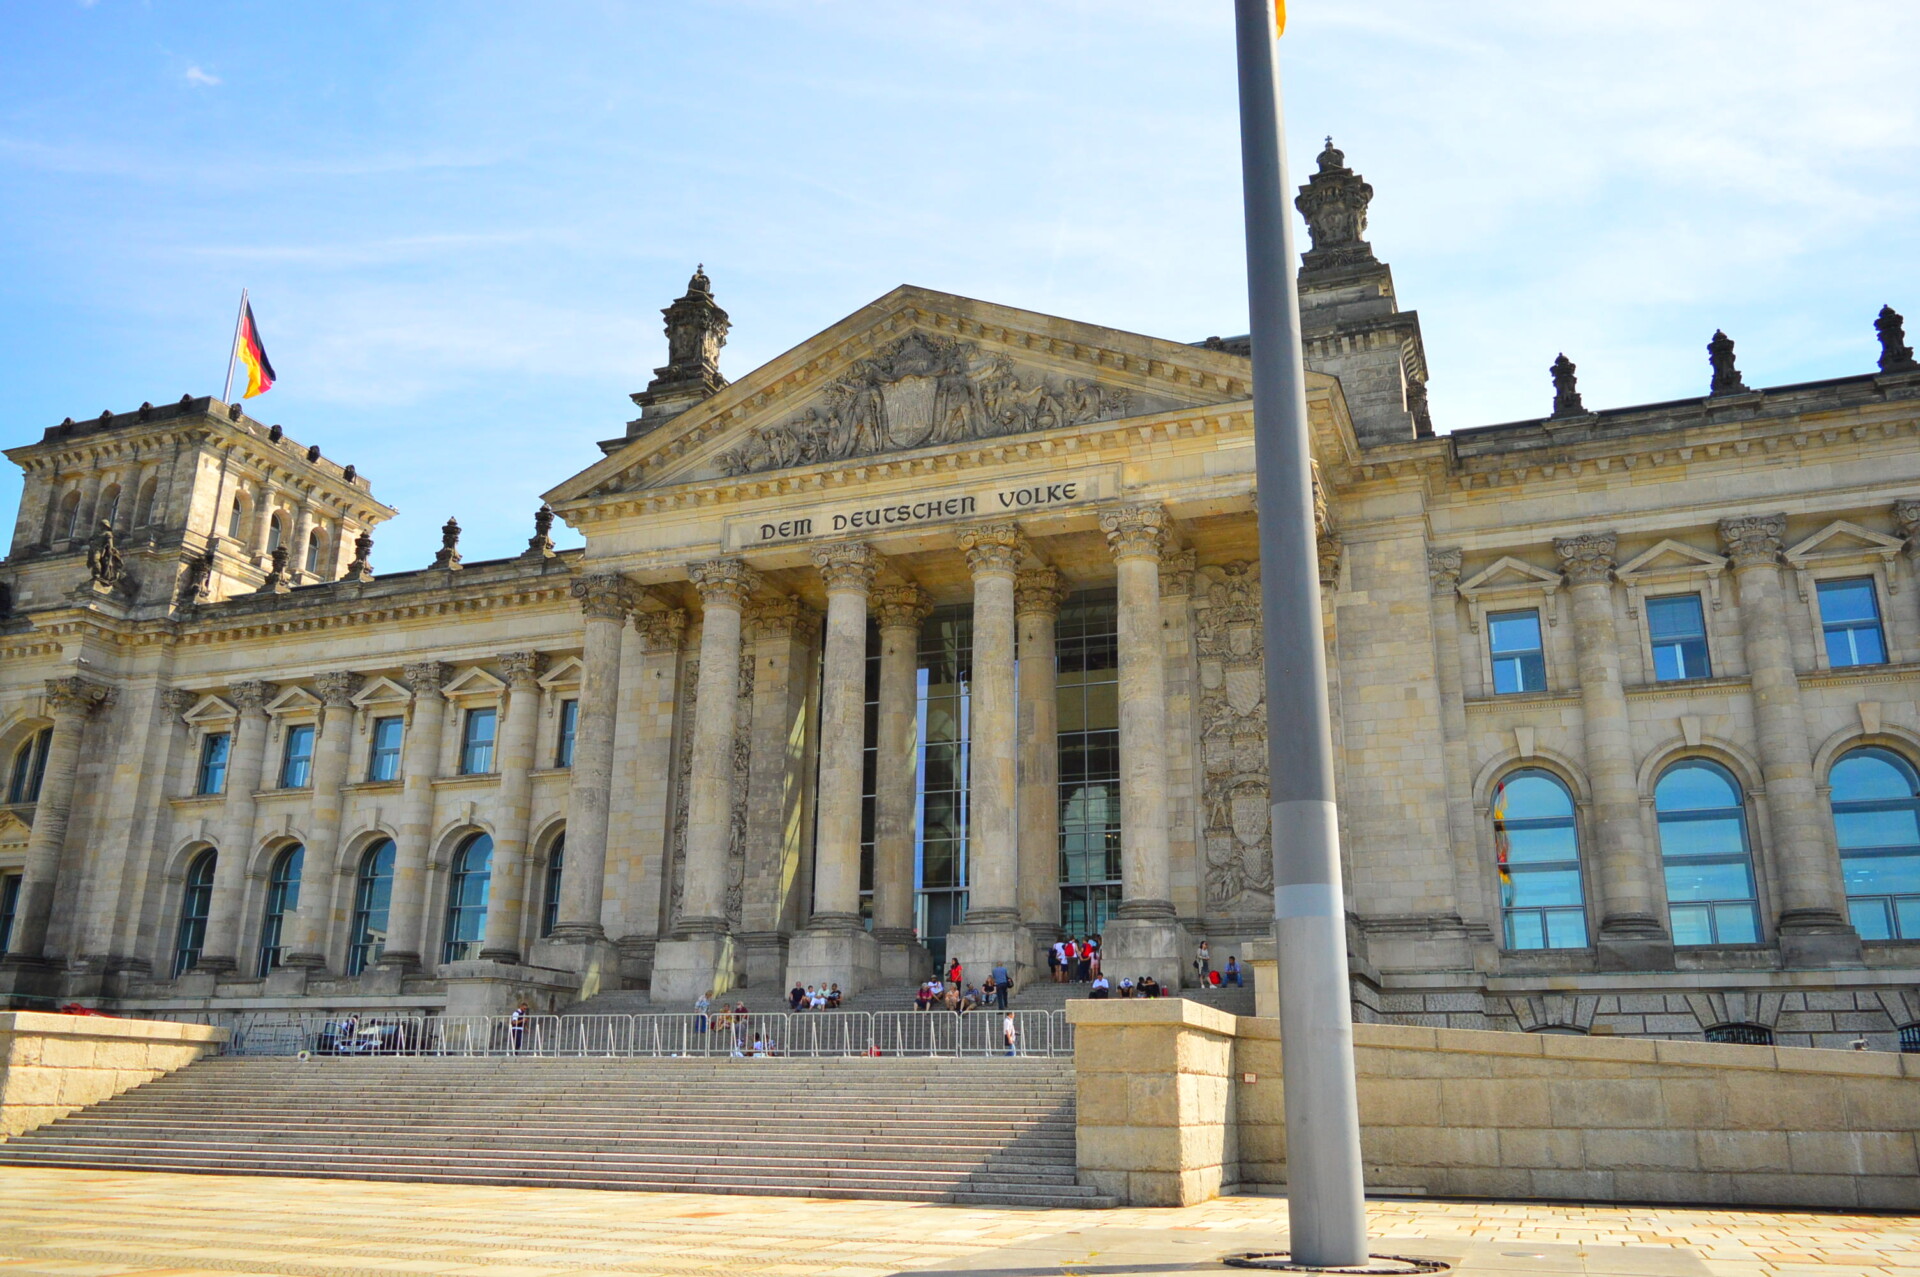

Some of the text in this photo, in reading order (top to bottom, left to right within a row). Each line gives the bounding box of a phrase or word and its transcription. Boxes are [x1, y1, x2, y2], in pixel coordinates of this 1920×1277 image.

[761, 482, 1077, 540] DEM DEUTSCHEN VOLKE
